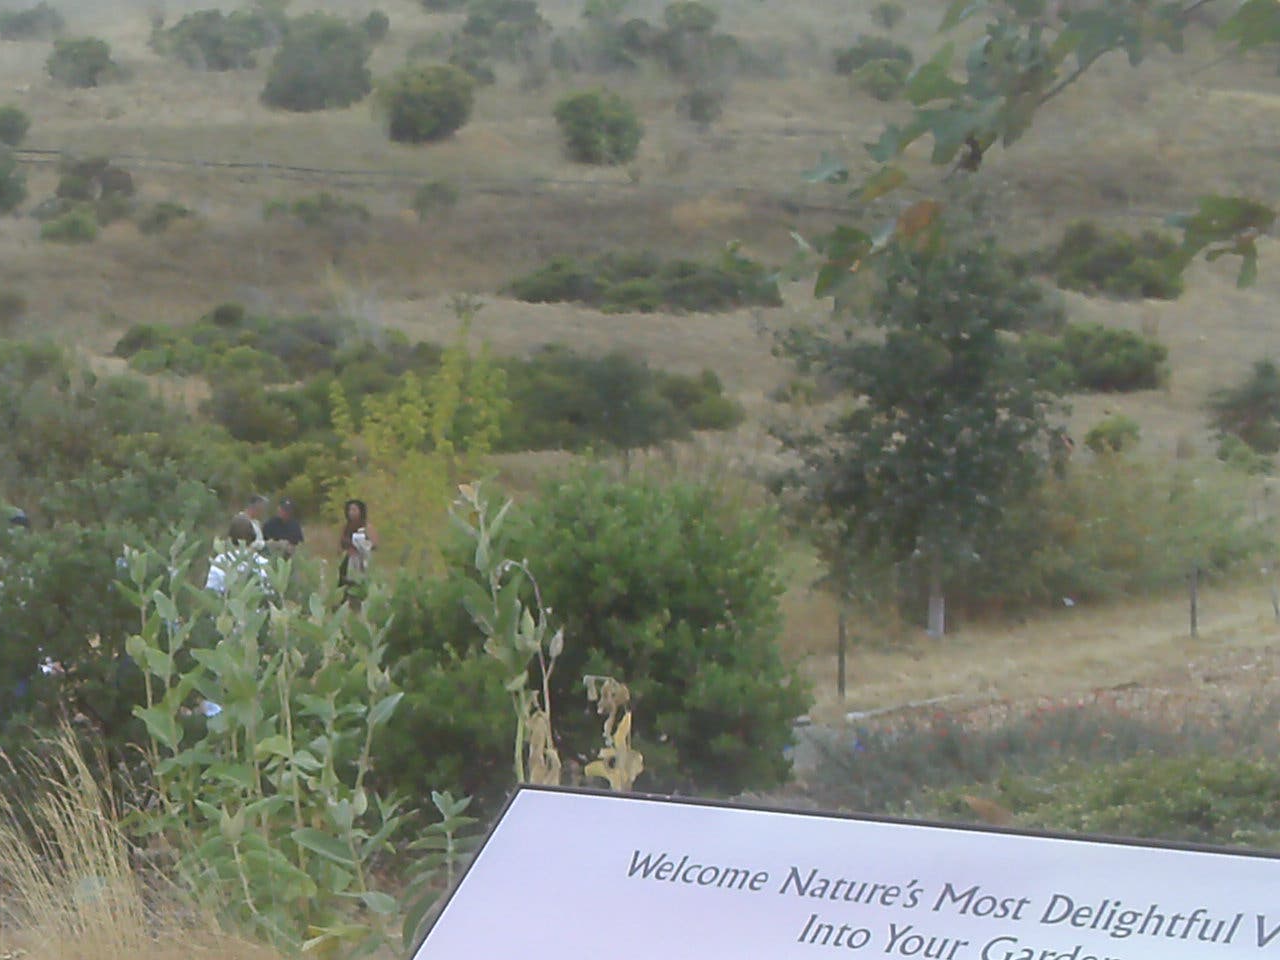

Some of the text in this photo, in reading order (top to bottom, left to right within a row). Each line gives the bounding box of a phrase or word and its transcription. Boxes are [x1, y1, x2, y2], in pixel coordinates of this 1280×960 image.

[627, 850, 769, 891] Welcome
[779, 866, 923, 909] Nature's
[932, 882, 1030, 920] Most
[1040, 893, 1243, 944] Delightful
[798, 914, 871, 949] Into
